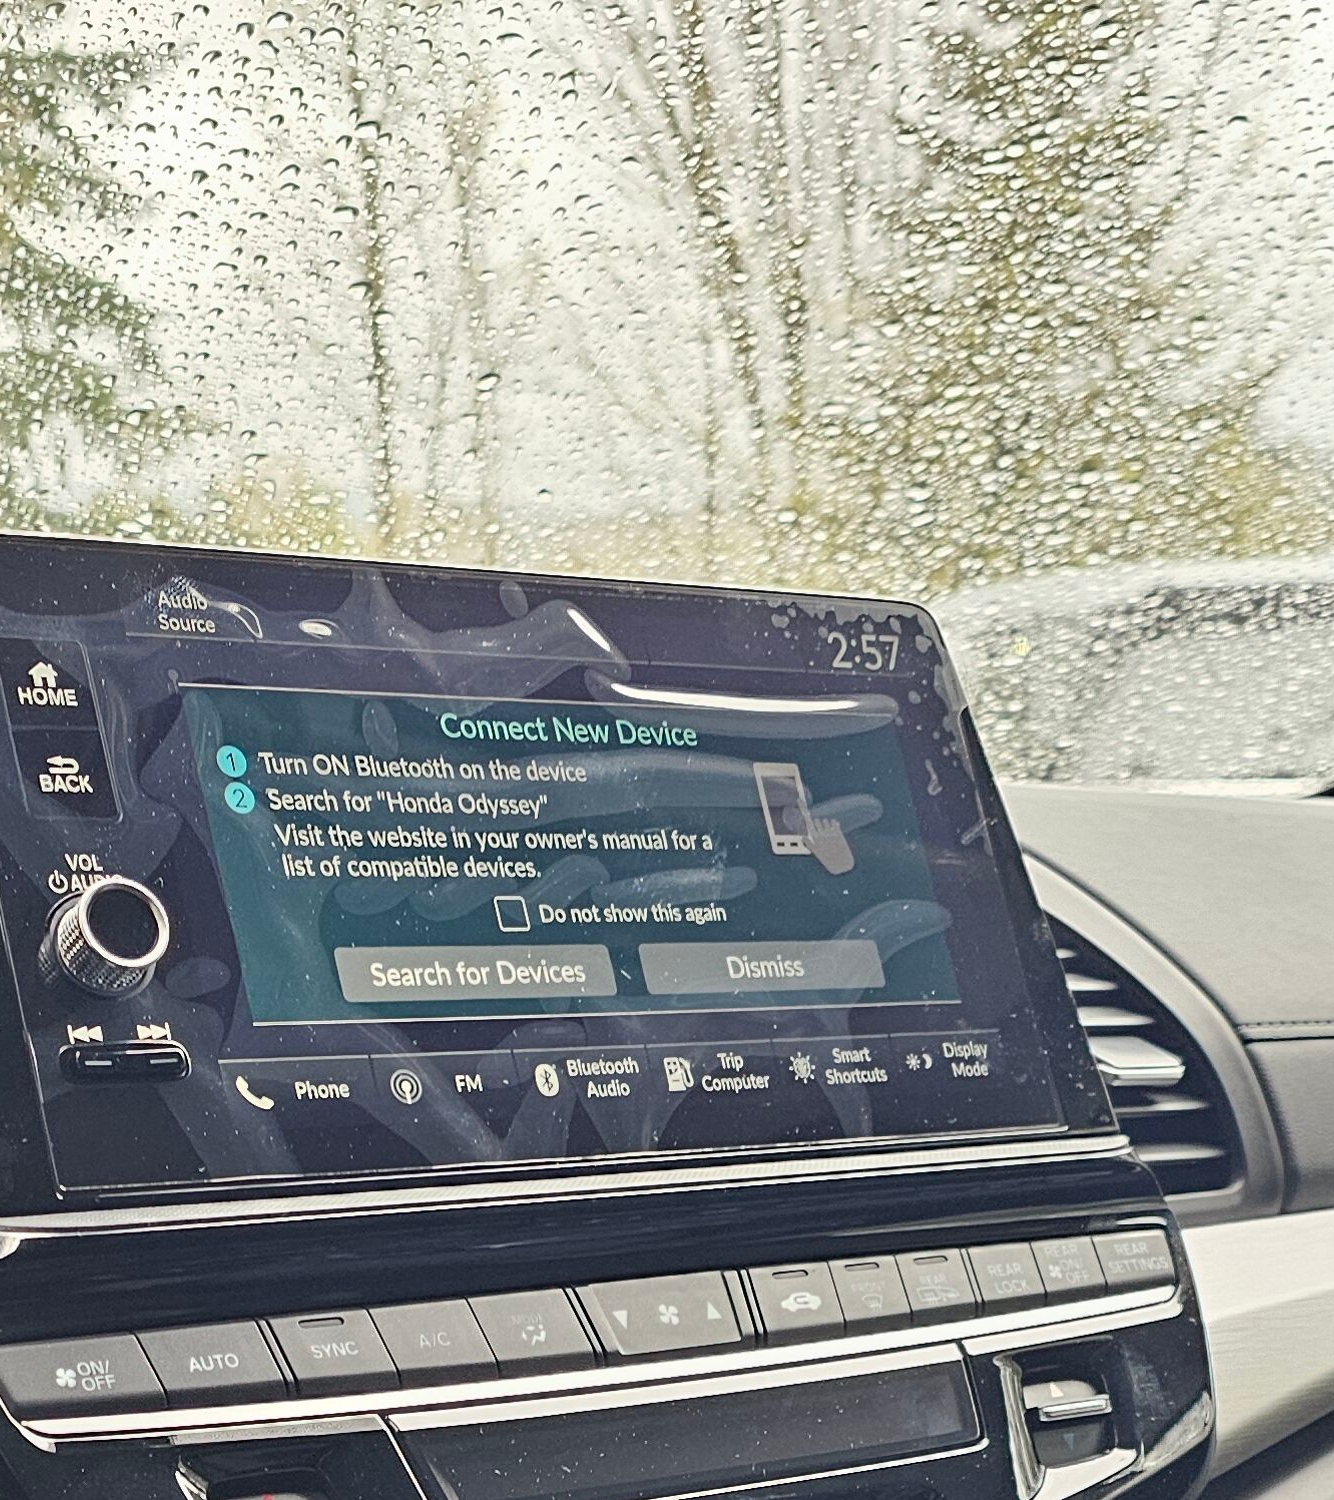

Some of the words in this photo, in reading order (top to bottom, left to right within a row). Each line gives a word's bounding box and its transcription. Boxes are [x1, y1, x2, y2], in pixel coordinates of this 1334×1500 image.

[157, 590, 208, 611] Audio
[158, 613, 216, 633] Source
[827, 631, 899, 671] 2:57
[18, 686, 79, 707] HOME
[440, 713, 549, 741] Connect
[553, 717, 610, 744] New
[616, 719, 698, 746] Device
[226, 752, 236, 772] 1
[258, 752, 308, 775] Turn
[312, 754, 350, 776] ON
[355, 755, 455, 779] Bluetooth
[459, 763, 485, 780] on
[489, 758, 522, 781] the
[527, 760, 588, 782] device
[38, 774, 94, 793] BACK
[233, 789, 247, 808] 2
[268, 789, 338, 812] Search
[343, 791, 372, 812] for
[377, 791, 453, 814] "Honda
[458, 792, 548, 819] Odyssey"
[274, 824, 325, 847] Visit
[328, 824, 363, 848] the
[367, 826, 447, 848] website
[450, 826, 471, 849] in
[474, 832, 519, 853] your
[525, 829, 598, 850] owner's
[603, 830, 668, 850] manual
[671, 830, 696, 850] for
[702, 834, 714, 850] a
[64, 853, 104, 872] VOL
[282, 854, 315, 878] list
[320, 854, 341, 877] of
[347, 855, 459, 881] compatible
[464, 856, 541, 878] devices.
[539, 904, 567, 923] Do
[571, 904, 601, 923] not
[604, 903, 648, 923] show
[651, 903, 682, 922] this
[686, 902, 727, 925] again
[370, 961, 452, 987] Search
[456, 961, 490, 986] for
[496, 959, 586, 985] Devices
[726, 954, 805, 979] Dismiss
[832, 1046, 872, 1064] Smart
[942, 1041, 988, 1060] Display
[566, 1057, 640, 1077] Bluetooth
[717, 1052, 744, 1072] Trip
[952, 1060, 989, 1078] Mode
[455, 1074, 484, 1093] FM
[701, 1072, 770, 1094] Computer
[825, 1066, 889, 1086] Shortcuts
[294, 1081, 350, 1100] Phone
[587, 1079, 631, 1098] Audio
[1044, 1244, 1078, 1259] REAR
[1115, 1242, 1148, 1257] REAR
[987, 1263, 1023, 1278] REAR
[1108, 1257, 1168, 1274] SETTINGS
[994, 1279, 1029, 1294] LOCK
[1066, 1271, 1090, 1284] OFF
[311, 1341, 359, 1359] SYNC
[419, 1332, 451, 1349] A/C
[77, 1359, 110, 1376] ON/
[189, 1353, 239, 1373] AUTO
[82, 1374, 116, 1392] OFF
